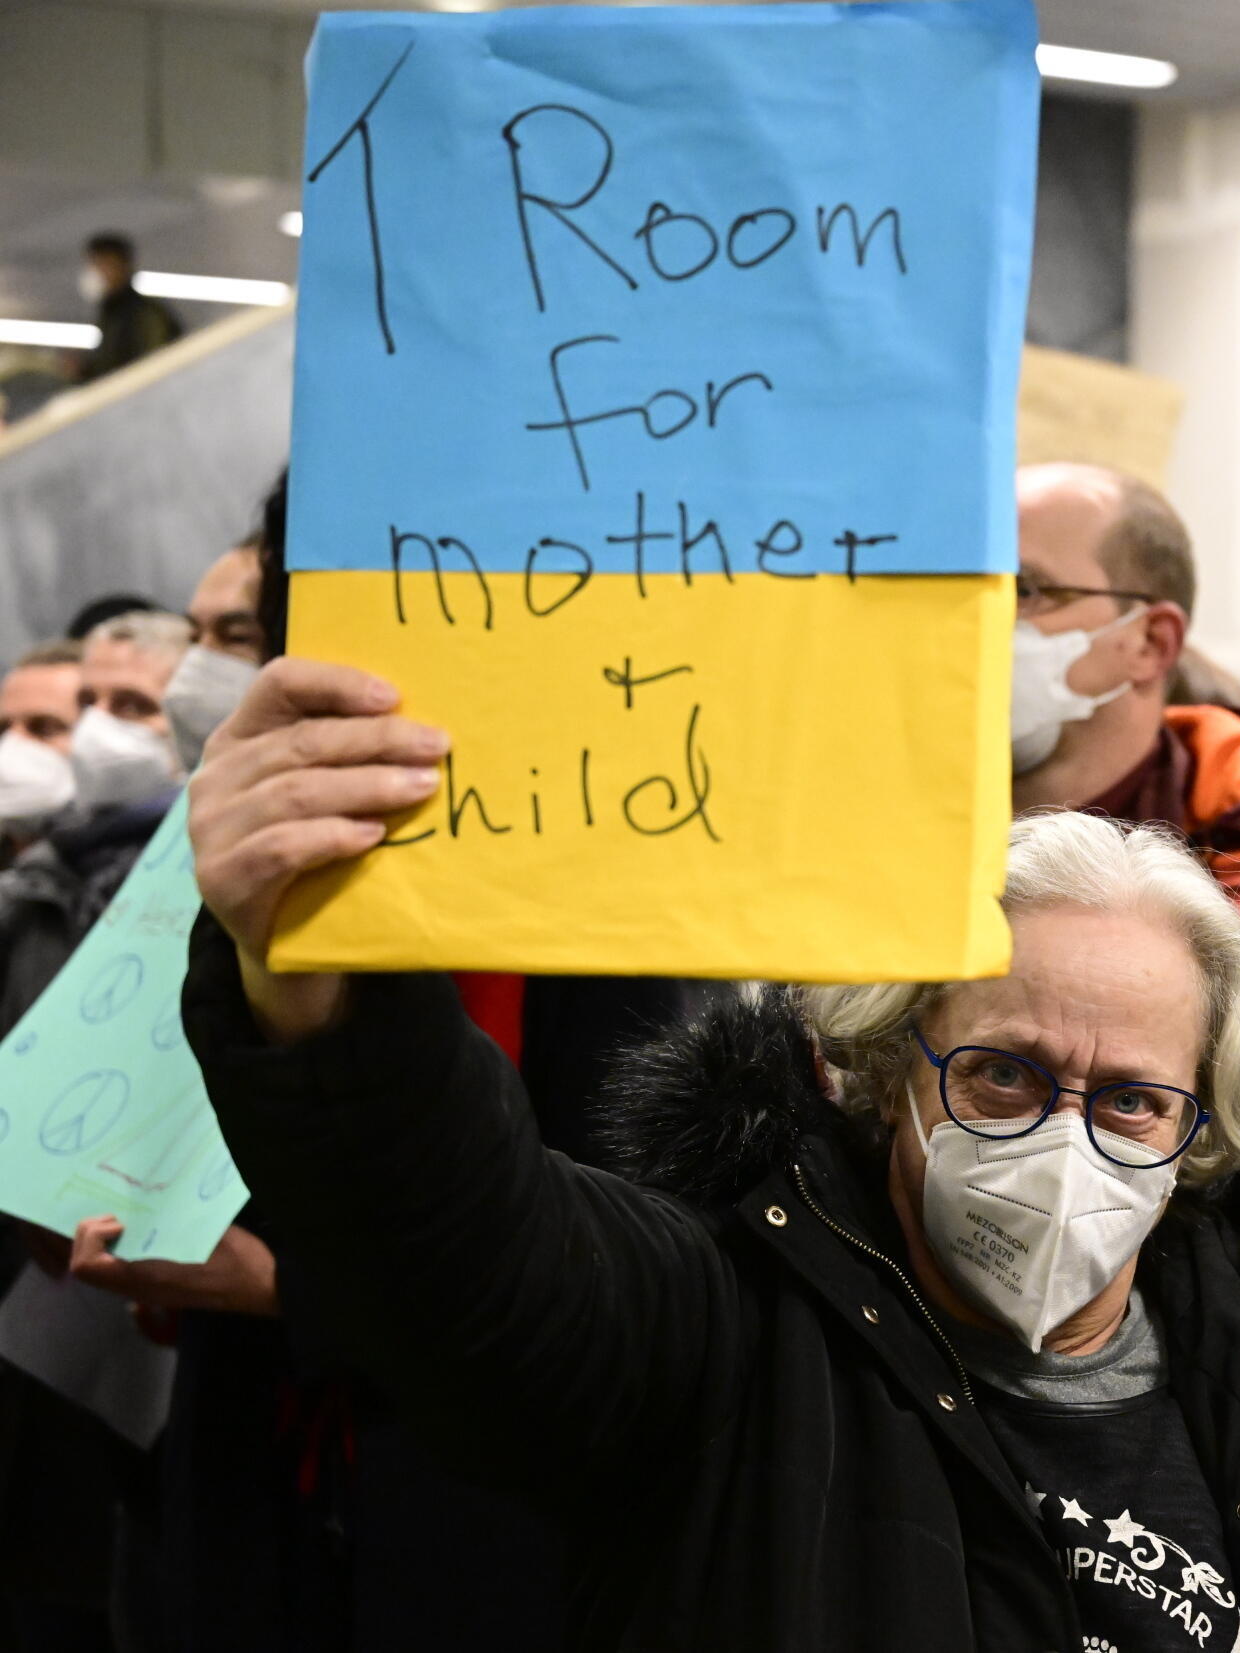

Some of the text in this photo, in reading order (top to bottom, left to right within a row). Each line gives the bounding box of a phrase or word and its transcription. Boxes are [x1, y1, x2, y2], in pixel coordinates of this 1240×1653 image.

[501, 104, 907, 313] Room
[525, 335, 773, 491] for
[389, 491, 898, 630] mother
[965, 1210, 1030, 1255] MEZORISON
[988, 1240, 1015, 1263] 0370
